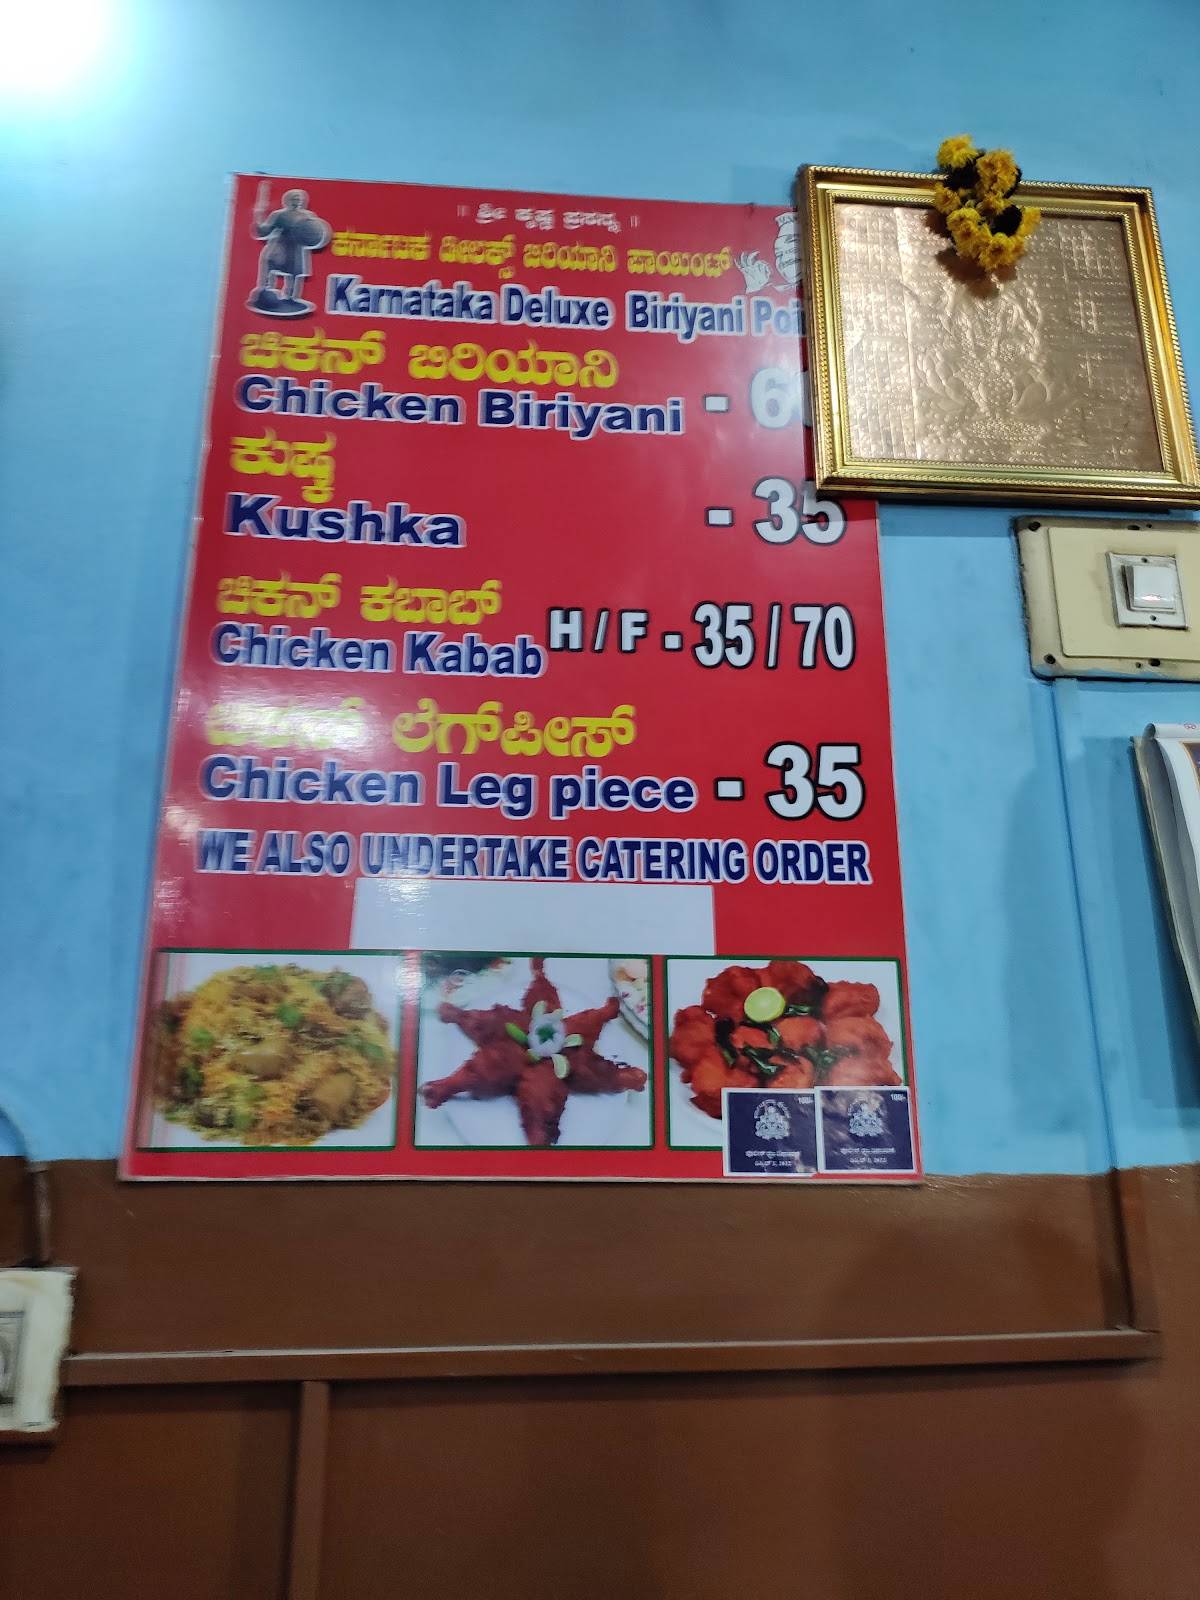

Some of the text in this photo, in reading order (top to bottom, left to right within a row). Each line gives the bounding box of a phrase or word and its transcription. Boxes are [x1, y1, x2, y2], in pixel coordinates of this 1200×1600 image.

[326, 273, 496, 324] Karnataka
[499, 283, 616, 330] Deluxe
[625, 291, 748, 344] Biriyani
[240, 327, 619, 388] ಚಿಕನ್ ಬಿರಿಯಾನಿ
[235, 373, 465, 424] Chicken
[478, 388, 685, 440] Biriyani
[223, 491, 465, 548] Kushka
[751, 475, 848, 546] 35
[217, 571, 502, 625] ಚಿಕನ್ ಕಬಾಬ್
[212, 621, 396, 673] Chicken
[403, 630, 549, 679] Kabab
[692, 600, 756, 670] 35
[791, 602, 857, 671] 70
[200, 753, 424, 806] Chicken
[436, 761, 538, 820] Leg
[549, 765, 698, 821] piece
[763, 740, 866, 822] 35
[195, 829, 873, 885] WE ALSO UNDERTAKE CATERING ORDER
